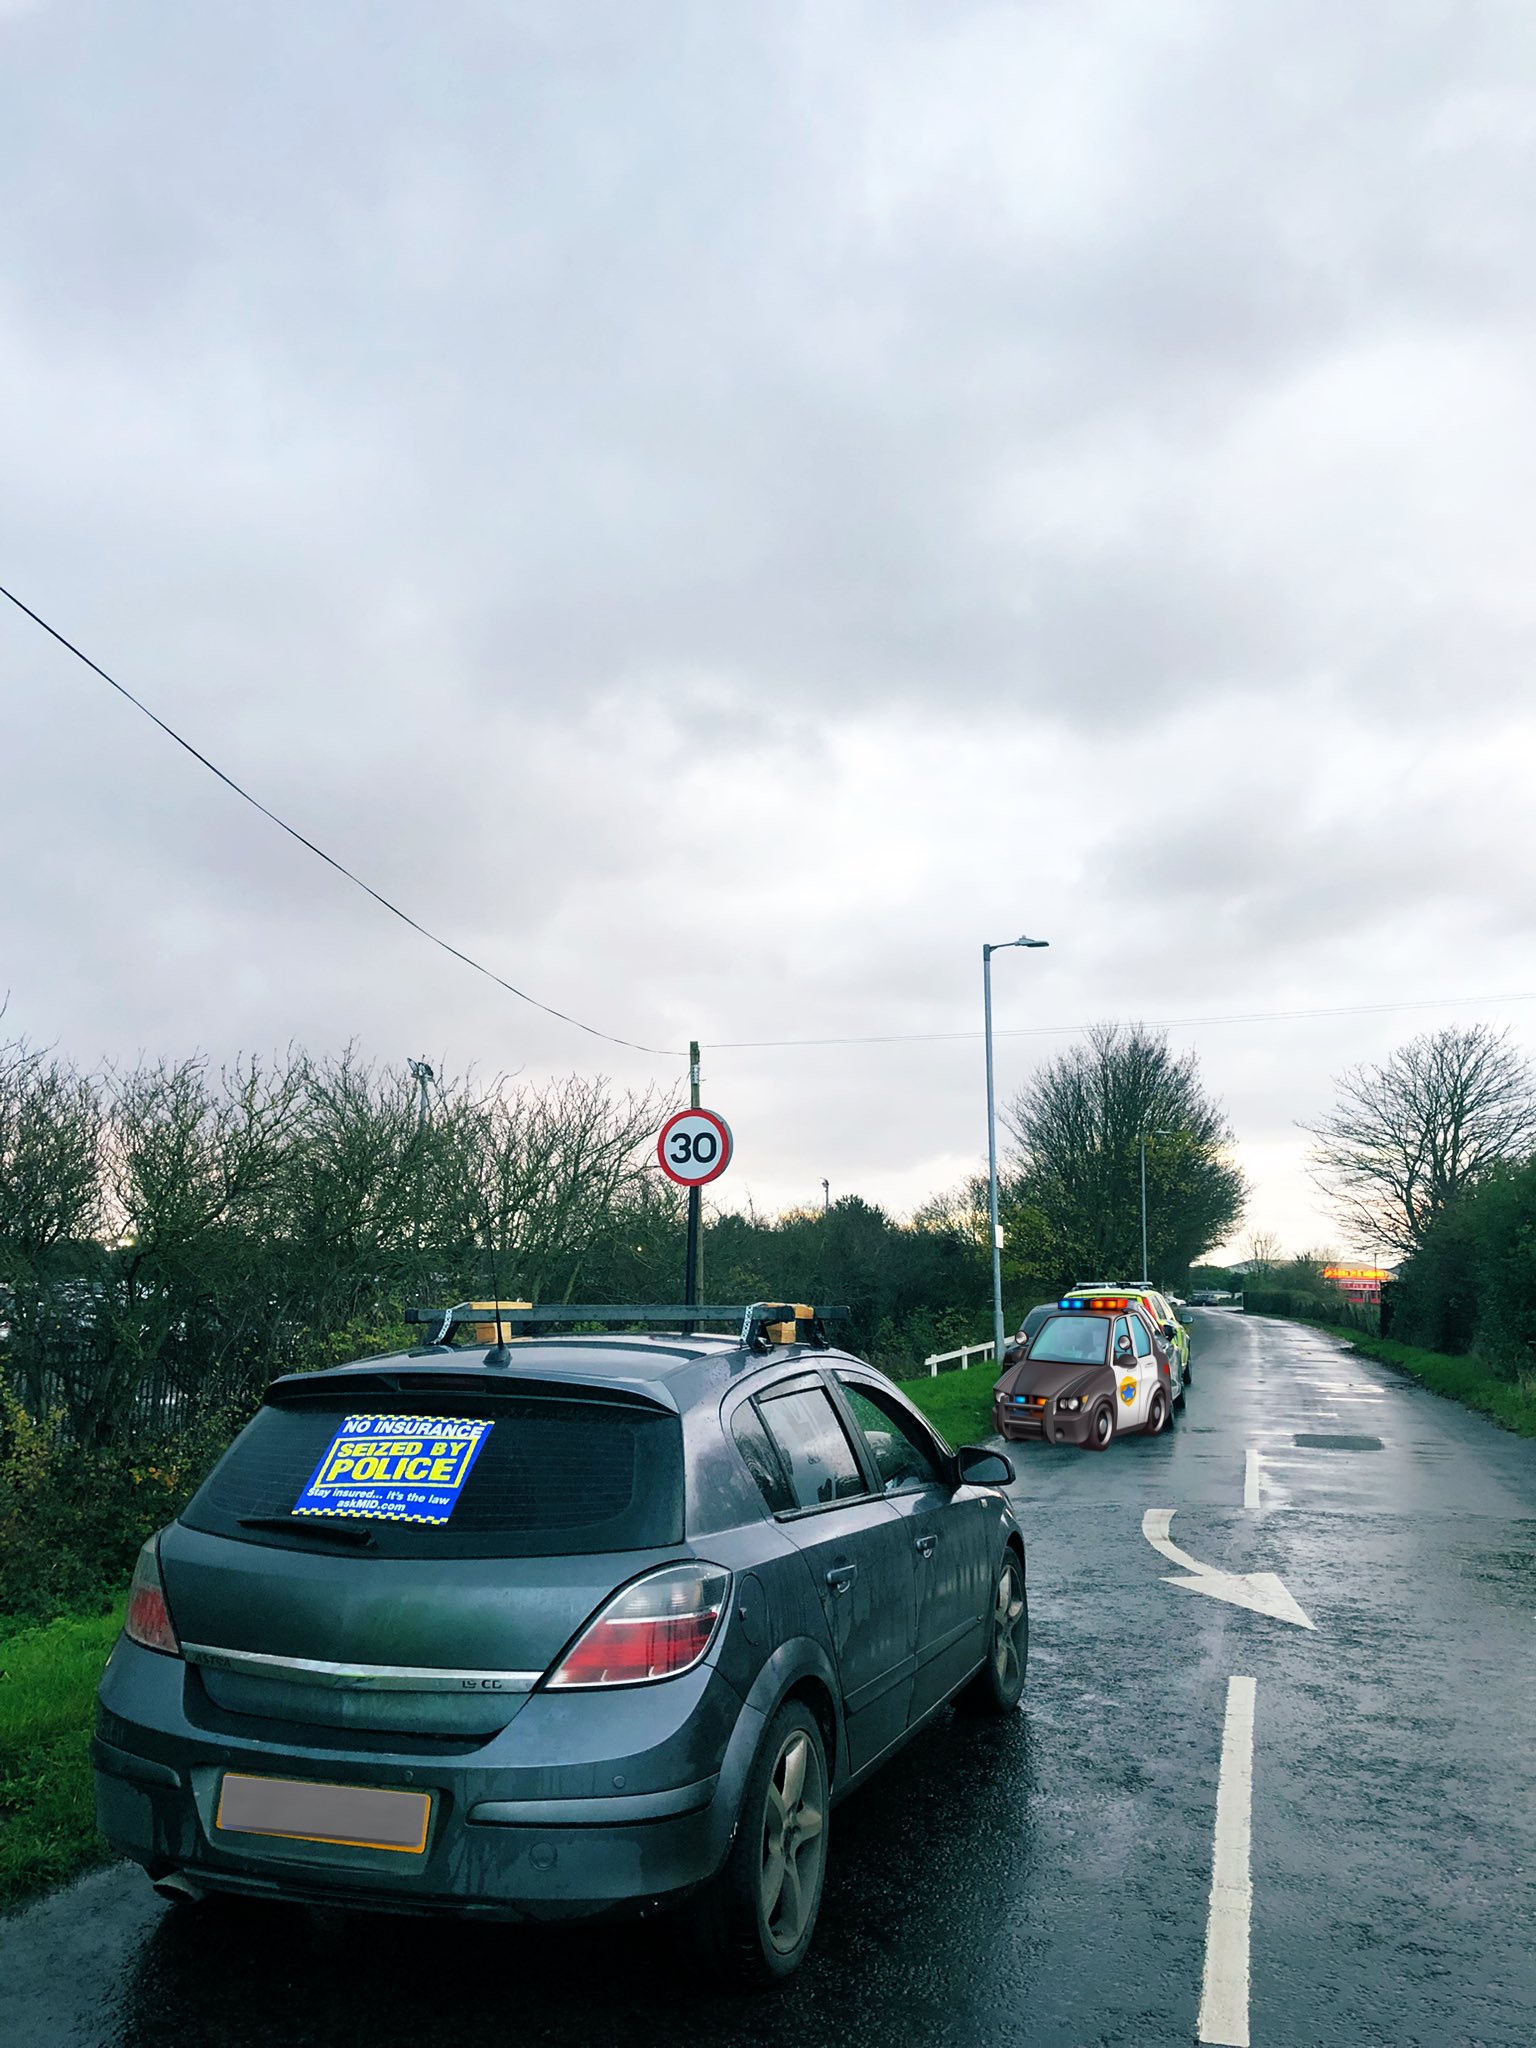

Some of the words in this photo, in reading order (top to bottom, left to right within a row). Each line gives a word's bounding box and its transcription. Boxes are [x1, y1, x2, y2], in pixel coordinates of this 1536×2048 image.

[670, 1132, 717, 1163] 30
[342, 1420, 371, 1433] NO
[373, 1421, 485, 1438] INSURANCE
[337, 1442, 423, 1457] SEIZED
[430, 1442, 467, 1456] BY
[326, 1457, 457, 1481] POLICE
[307, 1487, 331, 1499] Stay
[332, 1489, 383, 1500] insured...
[386, 1491, 404, 1501] it's
[407, 1492, 425, 1503] the
[428, 1494, 450, 1505] law
[337, 1499, 406, 1511] askMID.com
